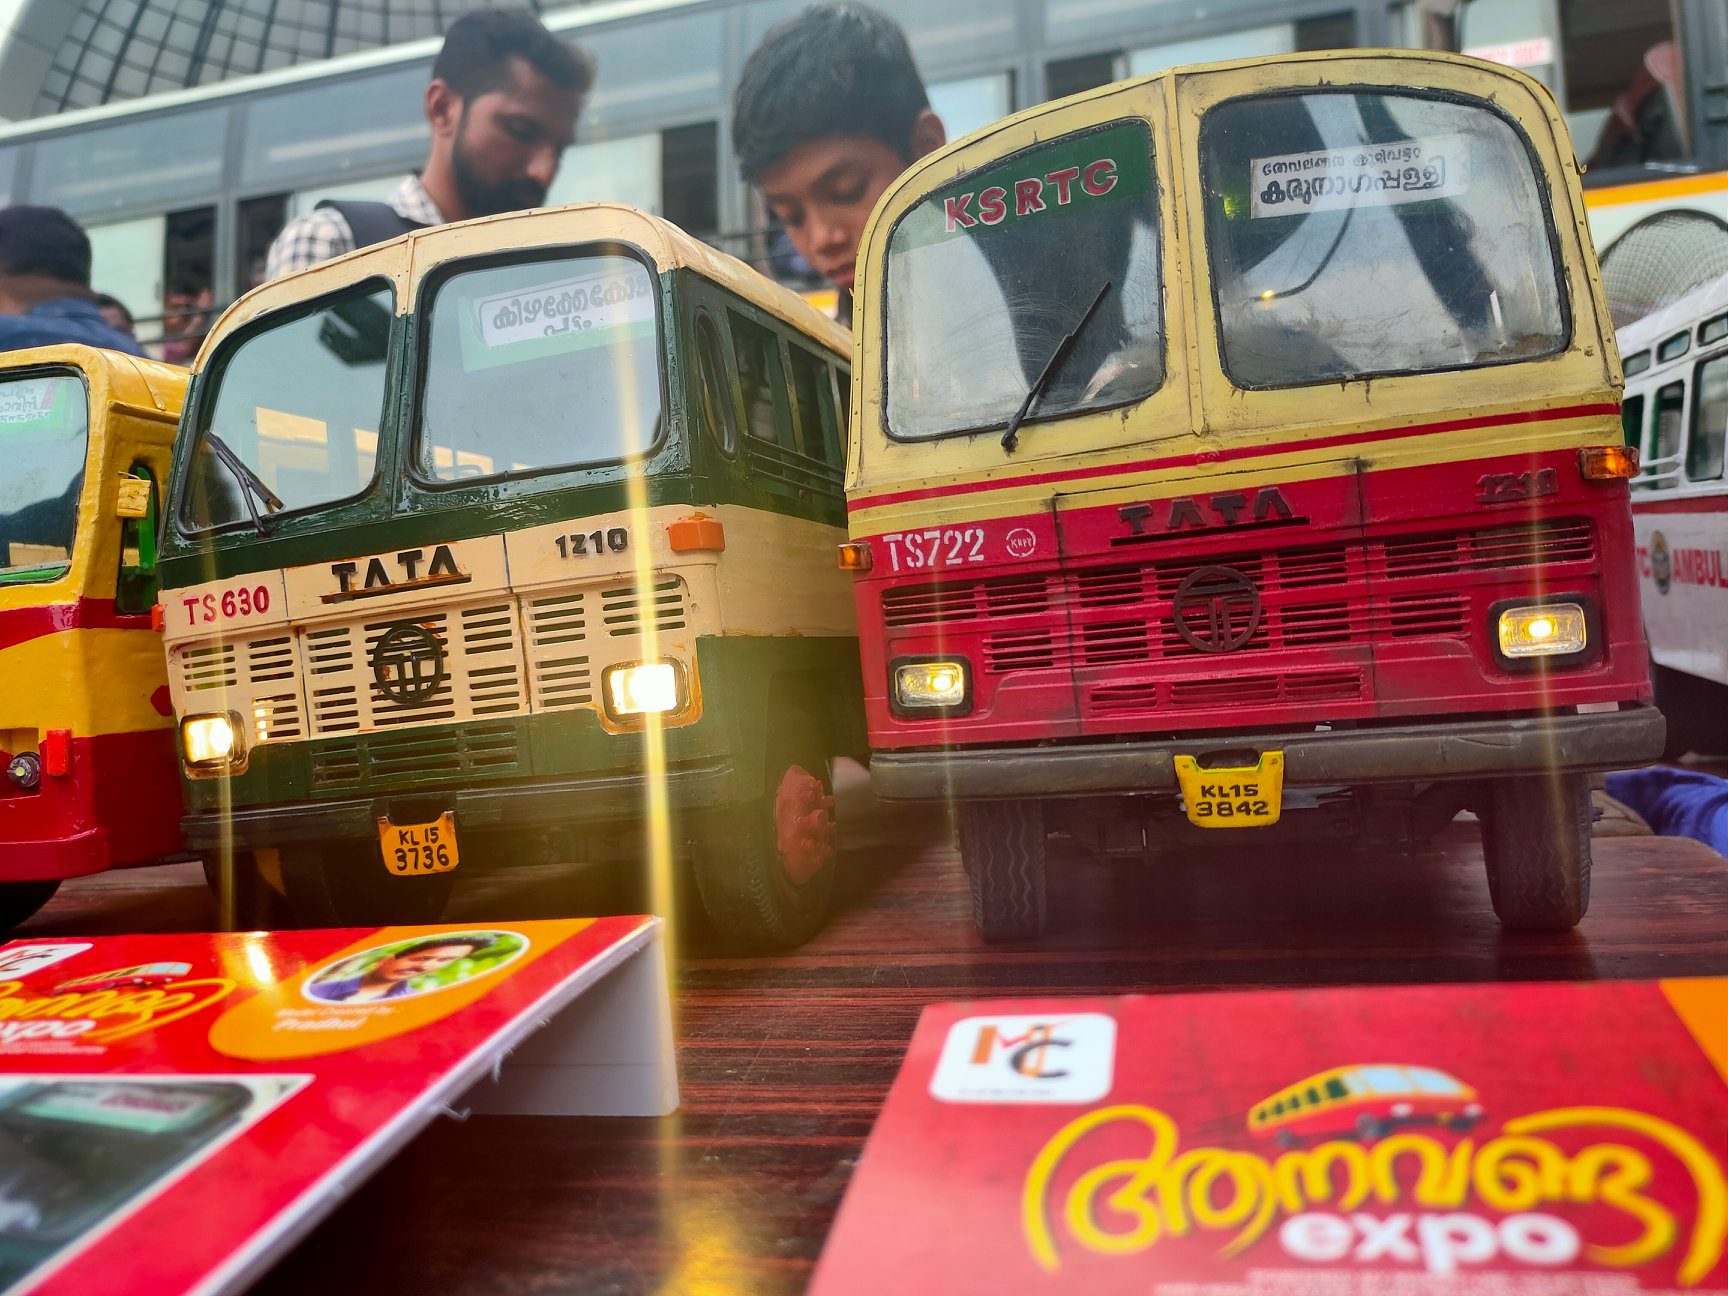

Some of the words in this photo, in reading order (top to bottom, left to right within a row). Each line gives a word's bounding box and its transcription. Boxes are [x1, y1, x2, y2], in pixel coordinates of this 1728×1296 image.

[943, 158, 1118, 233] KSRTC
[1118, 486, 1295, 535] TATA
[555, 526, 629, 559] 1210
[882, 528, 985, 571] TS722
[331, 544, 460, 593] TATA
[183, 584, 271, 627] TS630
[1196, 801, 1270, 817] 3842
[1201, 783, 1259, 798] KL15
[398, 829, 420, 845] KL
[424, 826, 440, 843] 15
[394, 843, 450, 872] 3736
[1022, 1104, 1728, 1288] ആനവണ്ടി
[1279, 1211, 1582, 1278] expo
